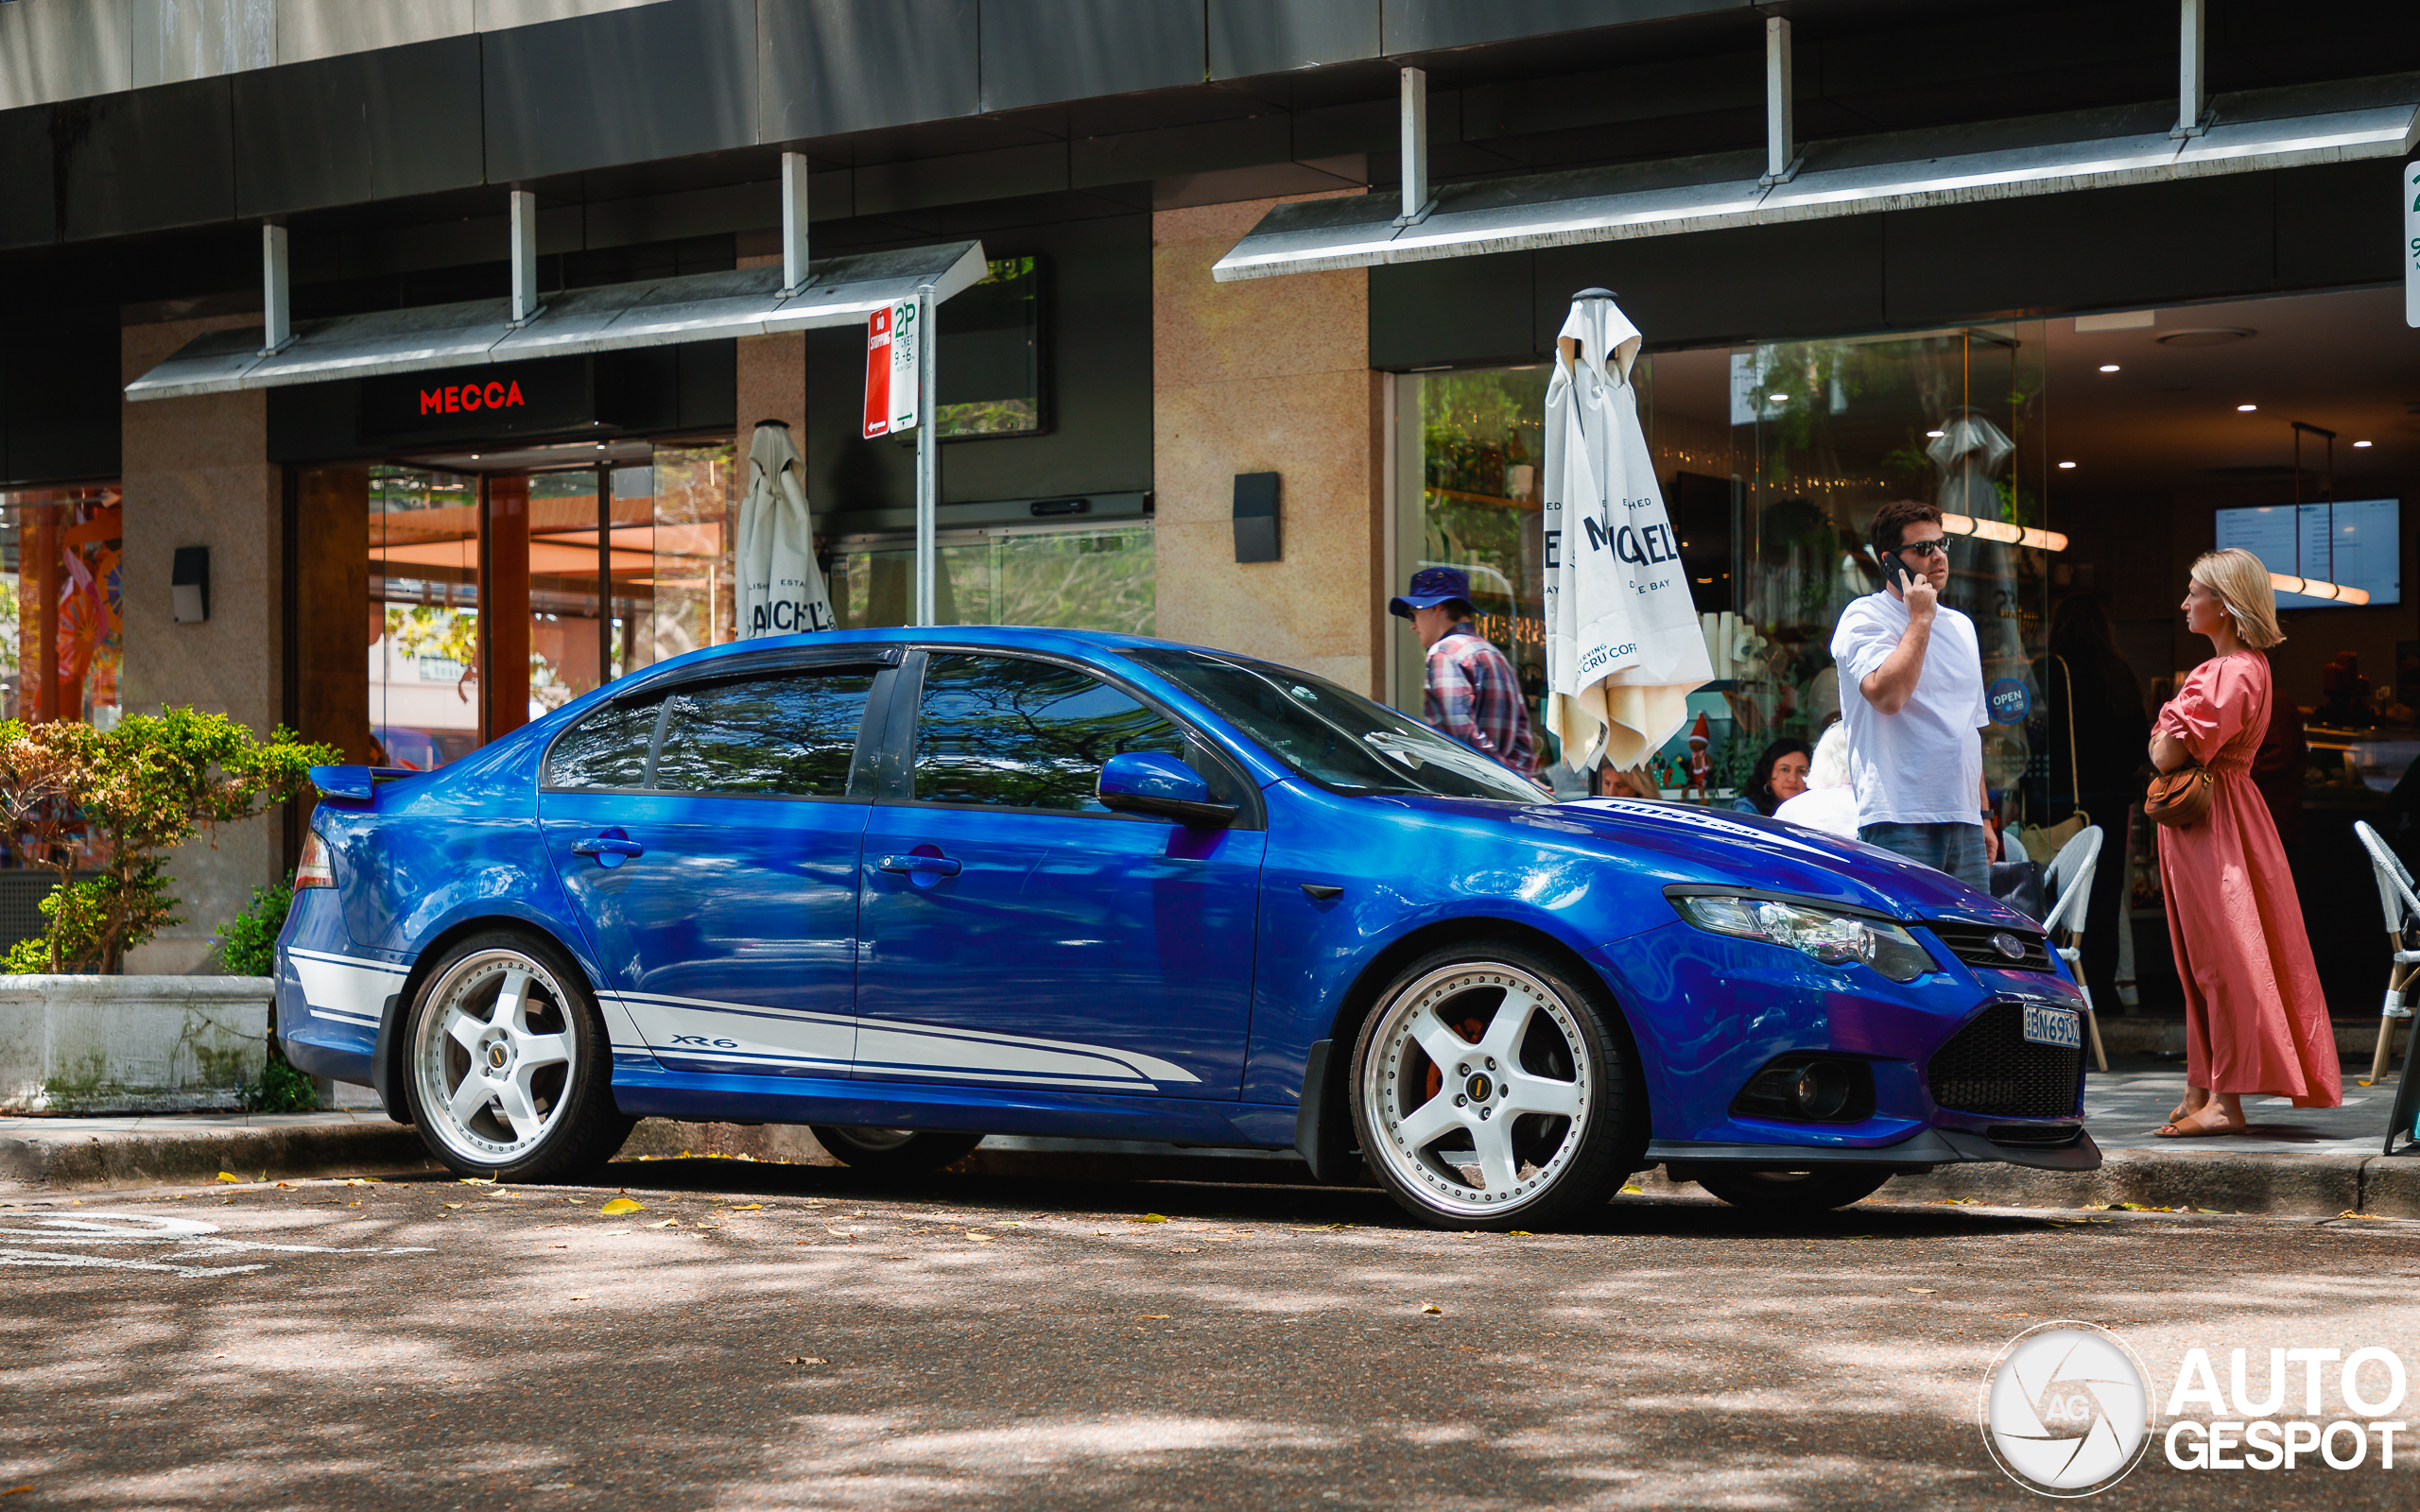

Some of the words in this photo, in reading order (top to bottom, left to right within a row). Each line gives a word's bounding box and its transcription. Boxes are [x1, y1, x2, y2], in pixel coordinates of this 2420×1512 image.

[895, 303, 915, 338] 2P
[420, 380, 525, 415] MECCA
[1650, 578, 1670, 591] BAY
[1993, 689, 2022, 706] OPEN
[671, 1034, 738, 1048] XR6
